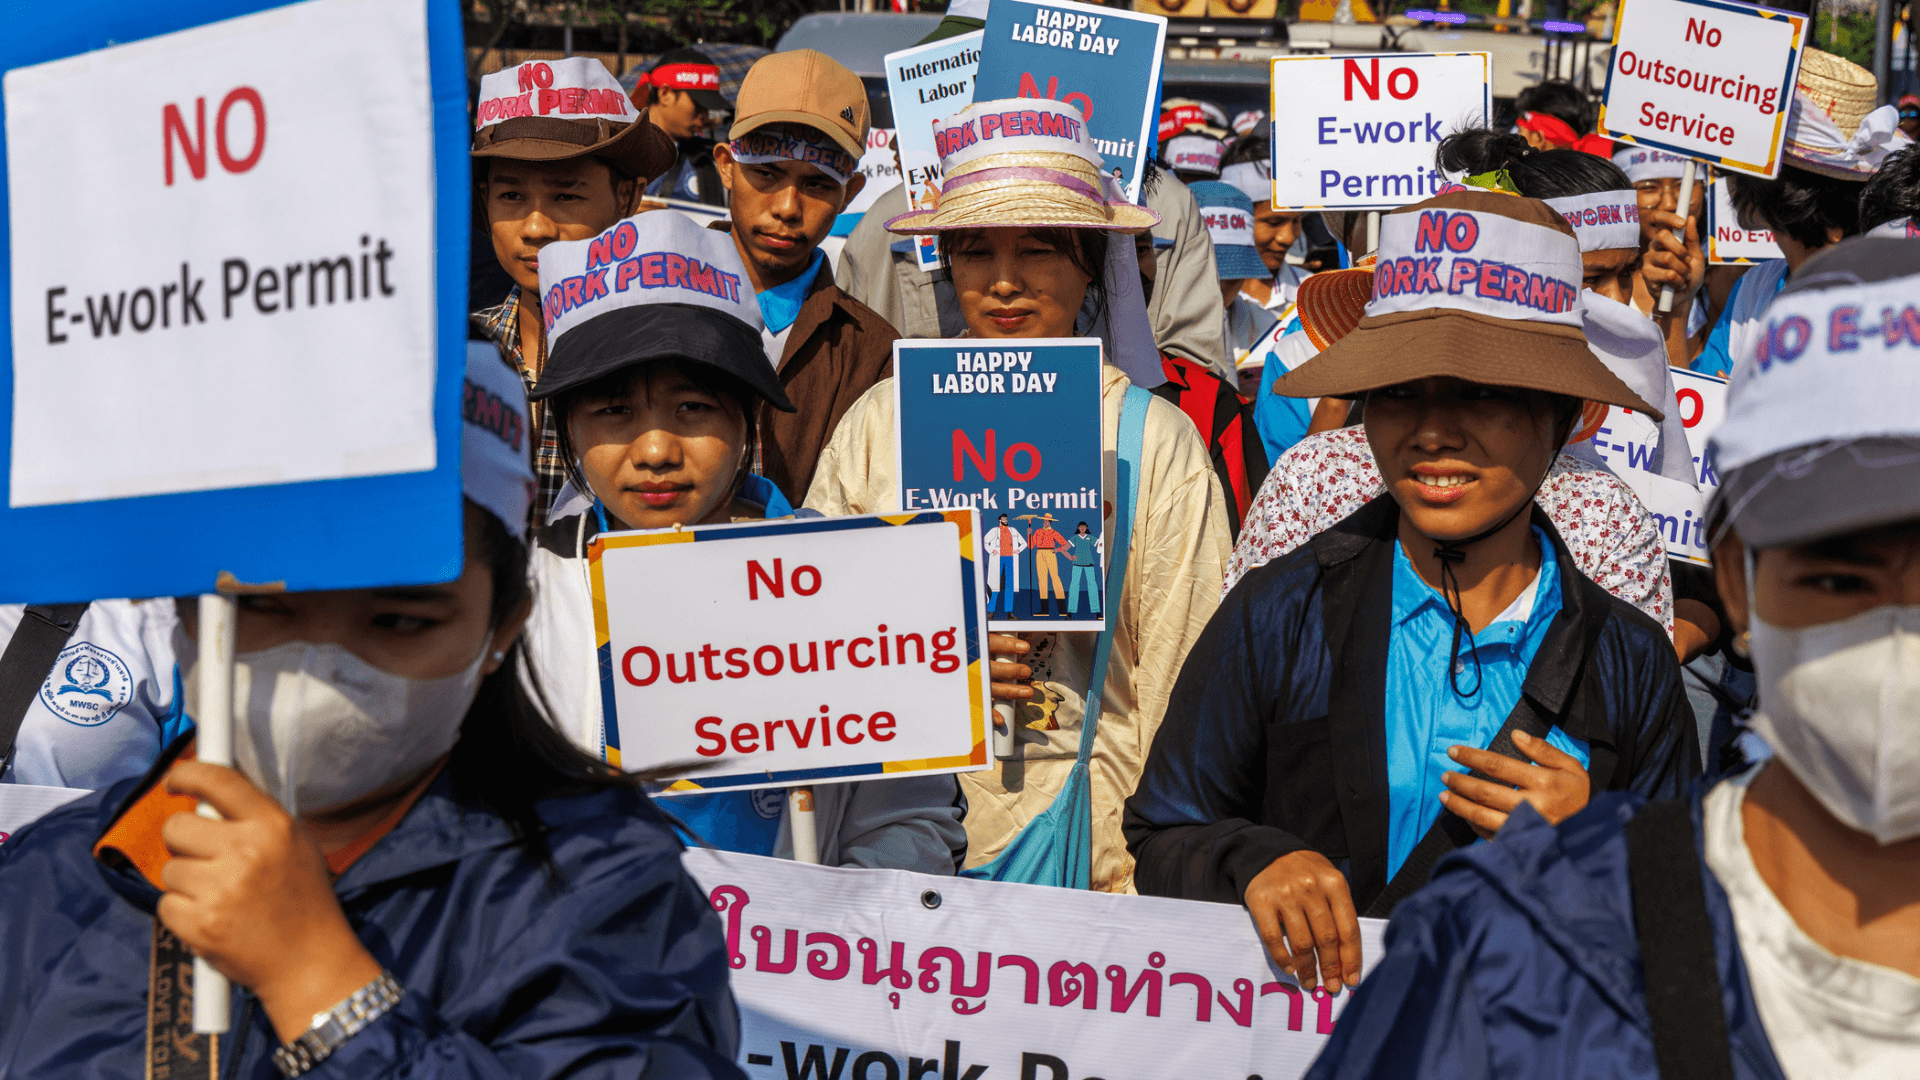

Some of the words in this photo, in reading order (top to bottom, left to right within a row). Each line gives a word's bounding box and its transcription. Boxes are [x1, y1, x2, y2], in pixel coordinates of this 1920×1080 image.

[1035, 8, 1102, 35] HAPPY
[1685, 17, 1722, 48] No
[1011, 23, 1075, 49] LABOR
[1079, 33, 1120, 56] DAY
[518, 62, 554, 93] NO
[899, 48, 982, 82] Internatio
[1344, 58, 1419, 101] No
[918, 80, 967, 104] Labor
[1618, 51, 1778, 115] Outsourcing
[538, 87, 628, 116] PERMIT
[161, 85, 267, 188] NO
[934, 119, 978, 160] ORK
[980, 110, 1081, 143] PERMIT
[1318, 113, 1443, 145] E-work
[1639, 102, 1735, 146] Service
[908, 164, 944, 186] E-W
[1320, 166, 1441, 198] Permit
[587, 221, 639, 271] NO
[1415, 210, 1480, 254] NO
[1718, 226, 1742, 243] No
[46, 261, 205, 345] E-work
[221, 233, 394, 320] Permit
[615, 252, 741, 304] PERMIT
[1447, 257, 1577, 314] PERMIT
[956, 351, 1032, 373] HAPPY
[932, 373, 1005, 394] LABOR
[1011, 372, 1057, 393] DAY
[952, 428, 1042, 482] No
[905, 487, 999, 509] E-Work
[1008, 486, 1098, 509] Permit
[747, 558, 822, 601] No
[621, 623, 961, 687] Outsourcing
[69, 699, 99, 711] MWSC
[694, 704, 897, 757] Service
